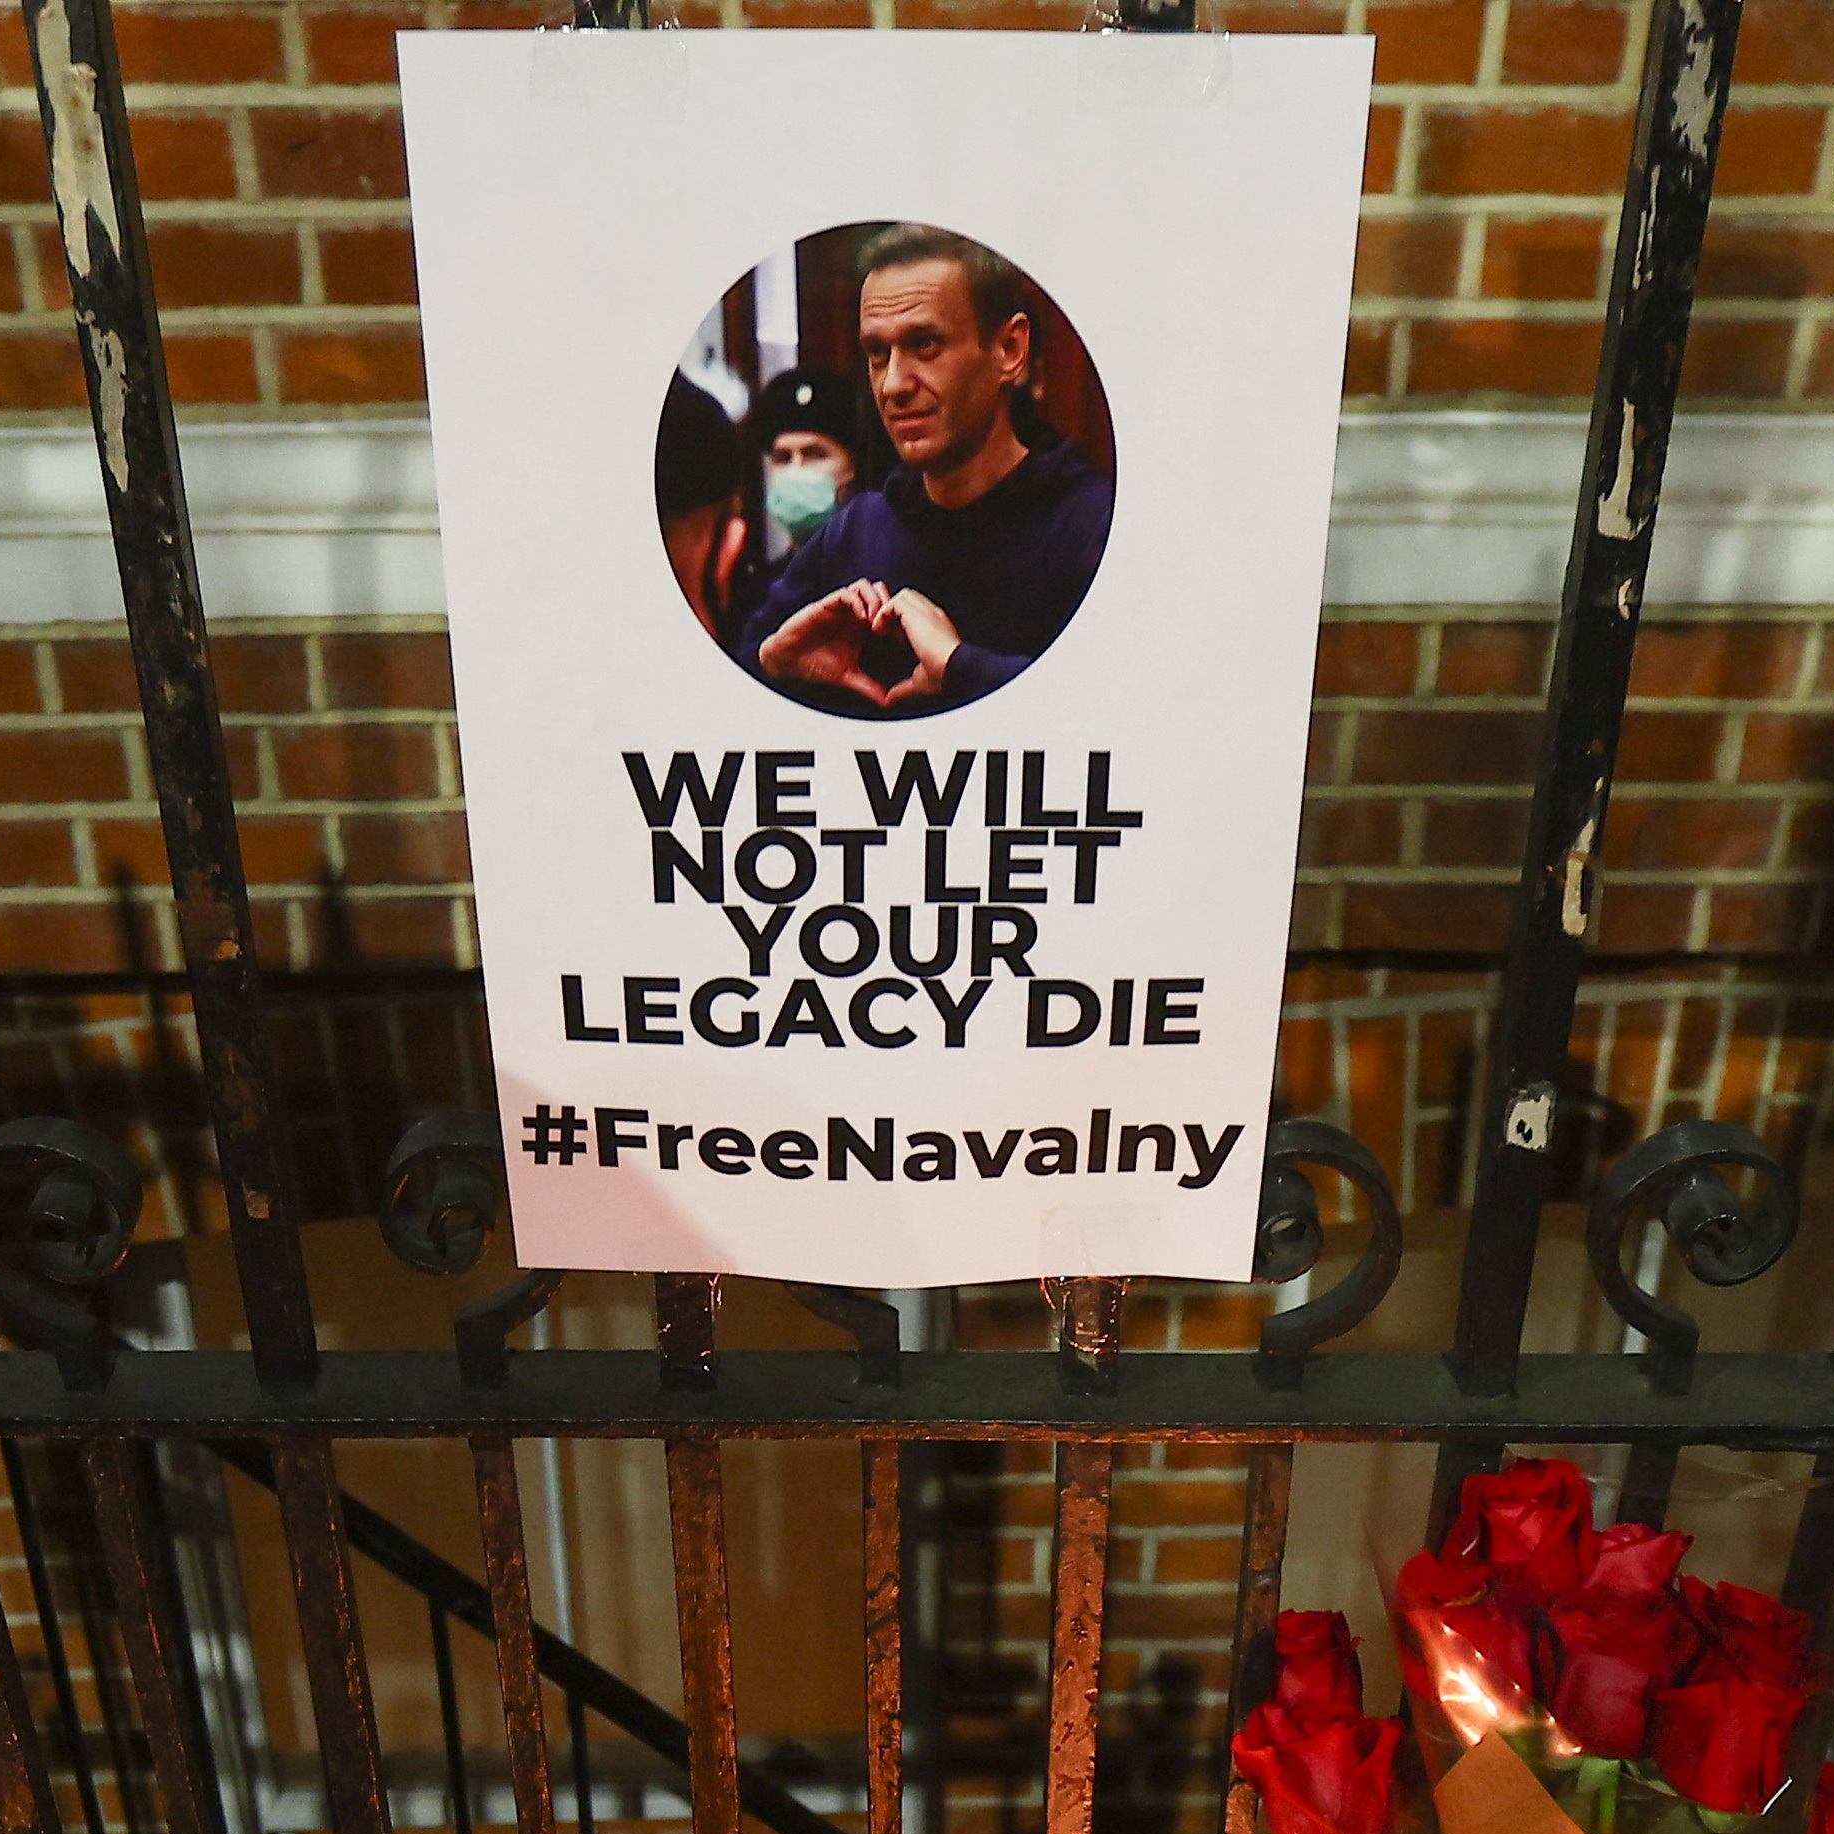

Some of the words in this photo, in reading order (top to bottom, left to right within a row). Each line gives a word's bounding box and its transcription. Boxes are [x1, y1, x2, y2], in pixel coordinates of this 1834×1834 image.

[622, 750, 817, 827] WE
[854, 750, 1143, 828] WILL
[651, 828, 887, 904] NOT
[924, 829, 1122, 904] LET
[723, 904, 1038, 978] YOUR
[561, 973, 993, 1048] LEGACY
[1026, 978, 1204, 1048] DIE
[521, 1104, 1245, 1189] #FreeNavalny
